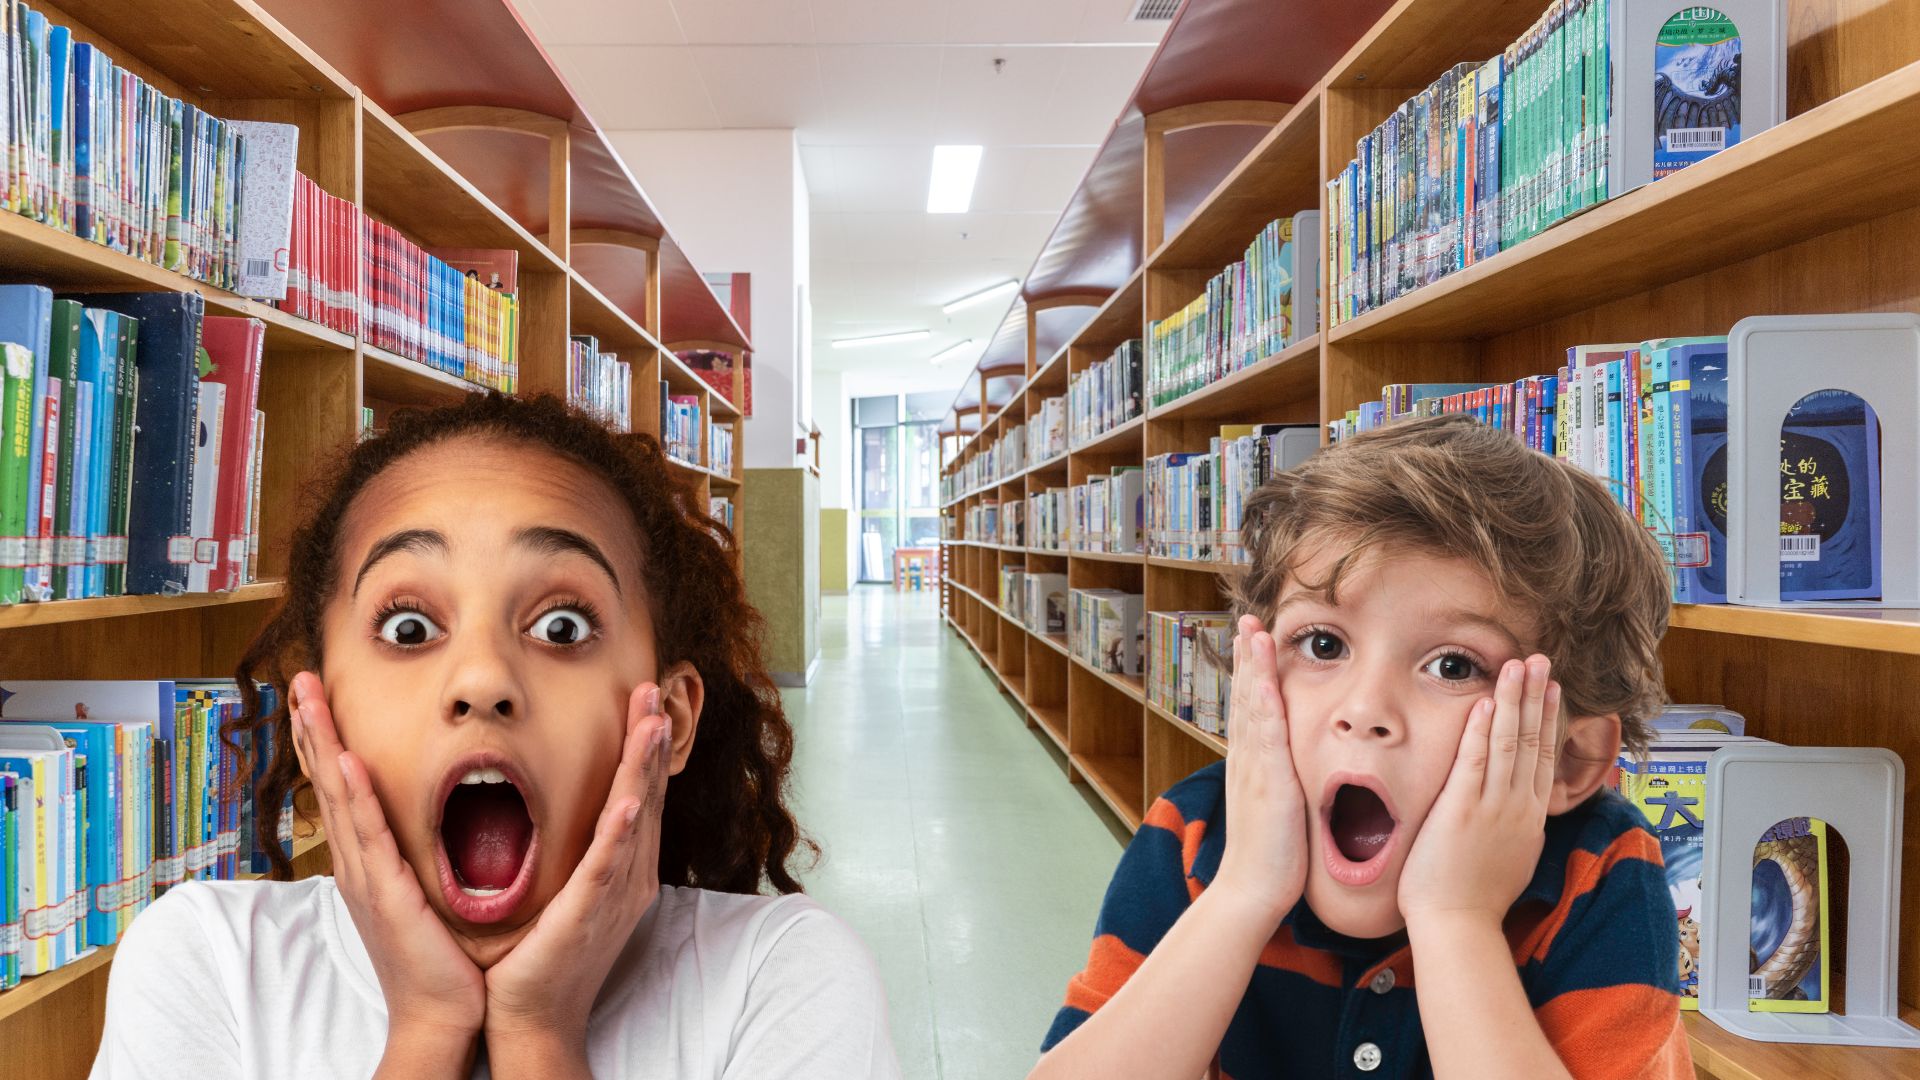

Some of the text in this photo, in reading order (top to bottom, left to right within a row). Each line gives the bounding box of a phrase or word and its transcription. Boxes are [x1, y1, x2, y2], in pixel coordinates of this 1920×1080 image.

[1780, 457, 1817, 476] 处的
[1783, 475, 1830, 499] 宝藏
[1644, 790, 1704, 831] 大
